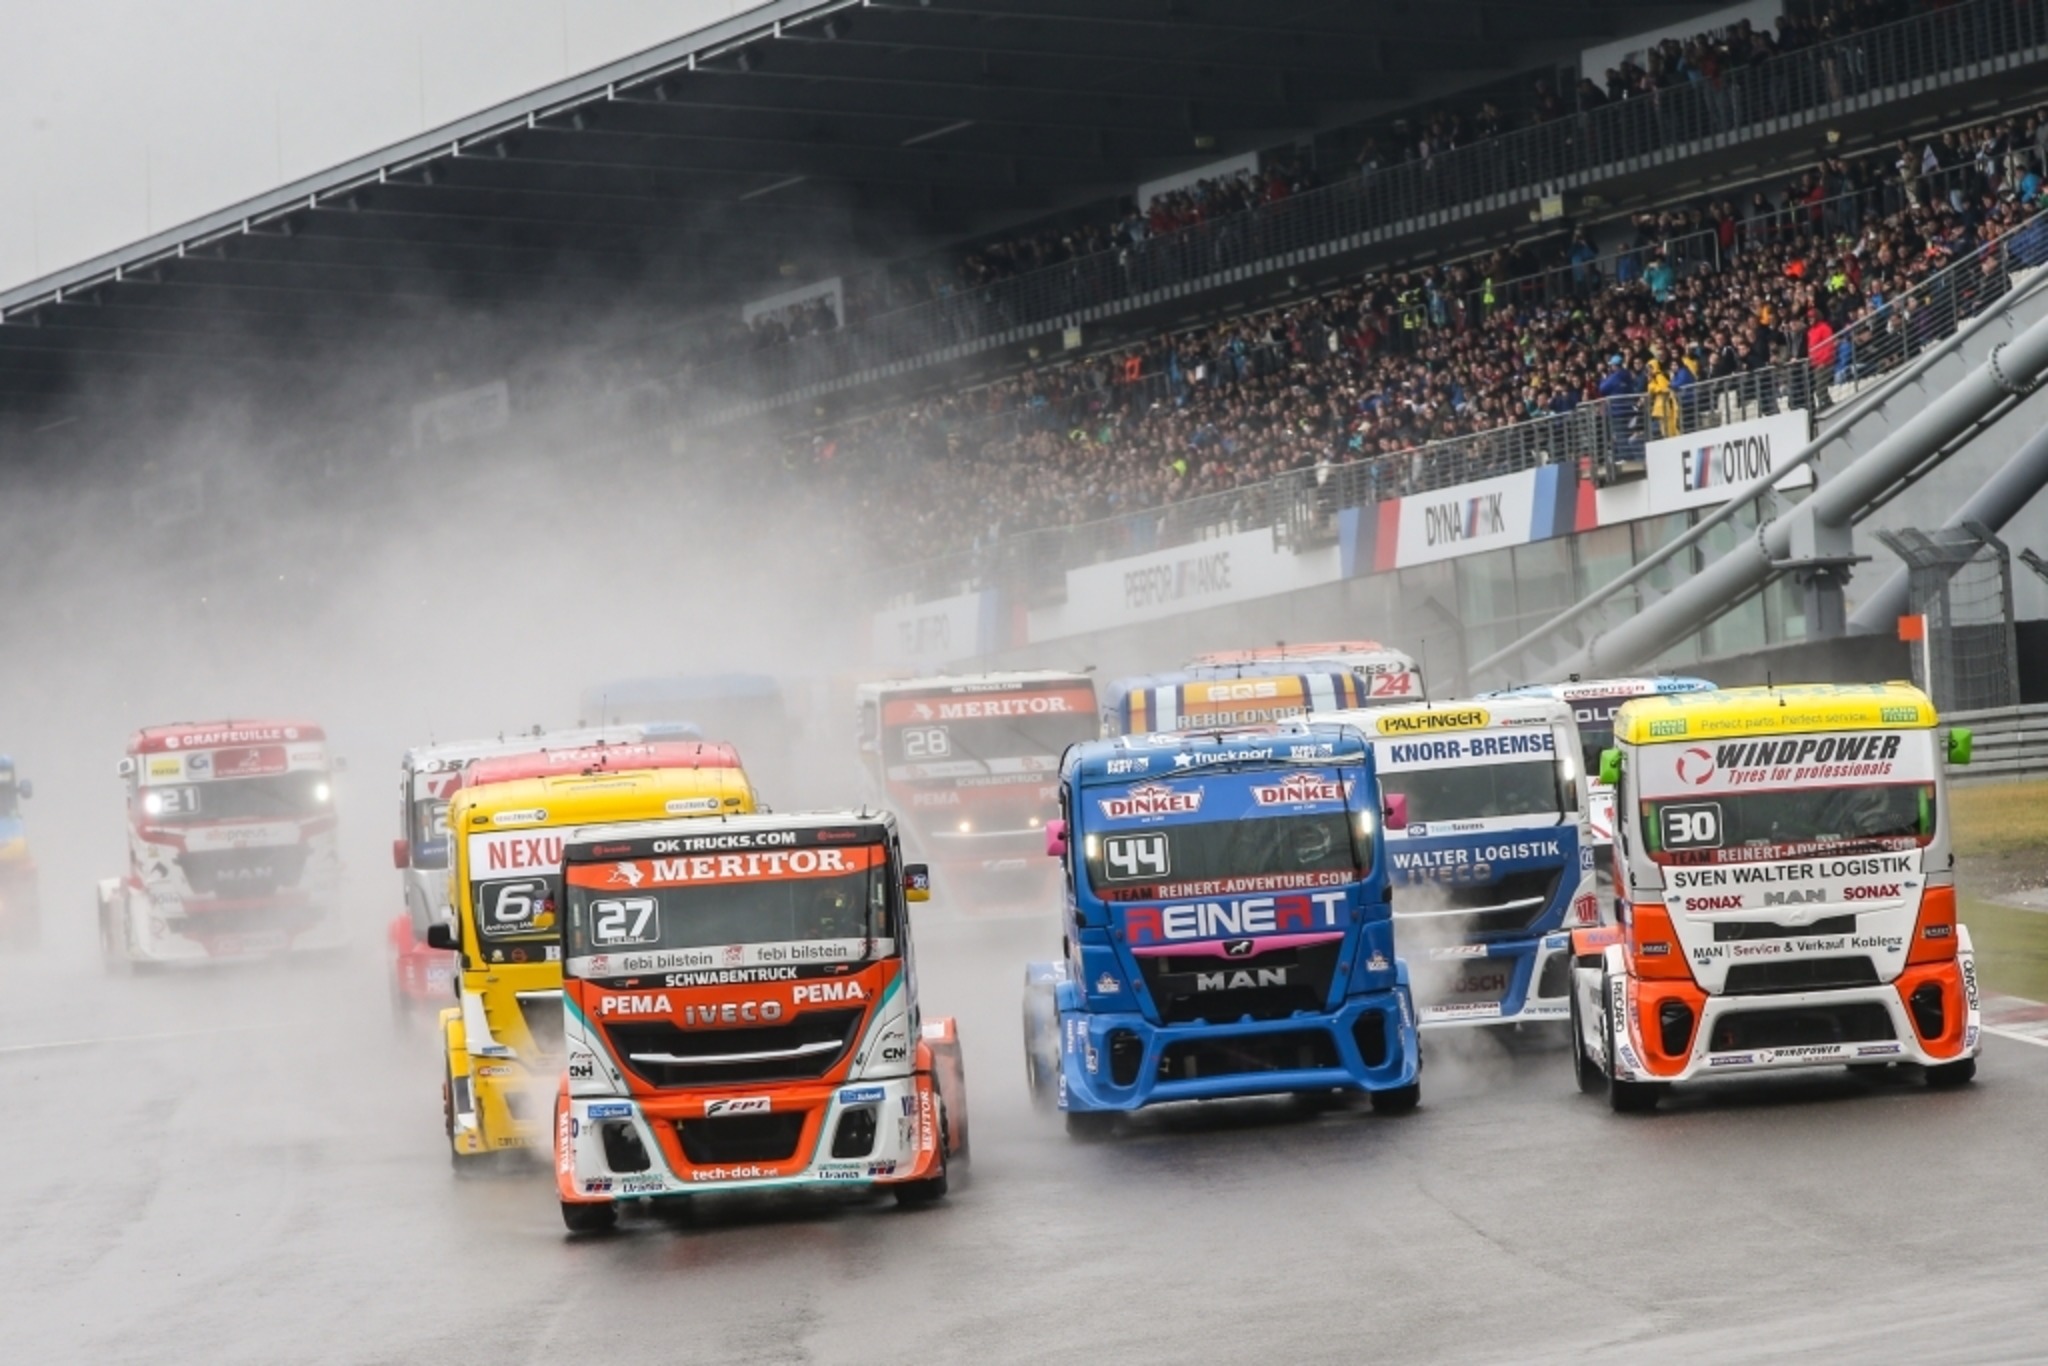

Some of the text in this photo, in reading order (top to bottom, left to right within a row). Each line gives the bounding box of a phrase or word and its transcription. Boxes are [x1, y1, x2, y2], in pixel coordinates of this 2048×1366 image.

[1372, 672, 1410, 696] 24
[939, 697, 1067, 720] MERITOR
[1385, 711, 1483, 733] PALFINGER
[183, 728, 281, 746] GRAFFEUILLE
[905, 730, 947, 756] 28
[1391, 734, 1554, 763] KNORR-BREMSE
[1716, 735, 1901, 769] WINDPOWER
[1728, 760, 1892, 785] Tyres for professionals
[1110, 795, 1196, 815] DINKEL
[1669, 812, 1716, 843] 30
[489, 837, 563, 871] NEXU
[653, 831, 796, 853] OK TRUCKS.COM
[652, 850, 845, 882] MERITOR
[1109, 839, 1165, 875] 44
[1393, 849, 1469, 869] WALTER
[1475, 840, 1560, 863] LOGISTIK
[1675, 857, 1911, 888] SVEN WALTER LOGISTIK
[1113, 871, 1353, 901] TEAM REINERT-ADVENTURE.COM
[1764, 889, 1827, 906] MAN
[1844, 884, 1901, 901] SONAX
[495, 884, 535, 923] 6
[1685, 895, 1742, 911] SONAX
[598, 900, 654, 939] 27
[1127, 891, 1346, 945] REINERT
[758, 944, 848, 962] febi bilstein
[1693, 936, 1903, 959] MAN Service & Verkauf Koblenz
[623, 952, 714, 971] febi bilstein
[665, 966, 798, 987] SCHWABENTRUCK
[1197, 967, 1287, 991] MAN
[1448, 975, 1505, 993] OSCH
[602, 994, 673, 1015] PEMA
[793, 981, 865, 1005] PEMA
[686, 1001, 782, 1025] IVECO
[729, 1100, 768, 1111] FPT
